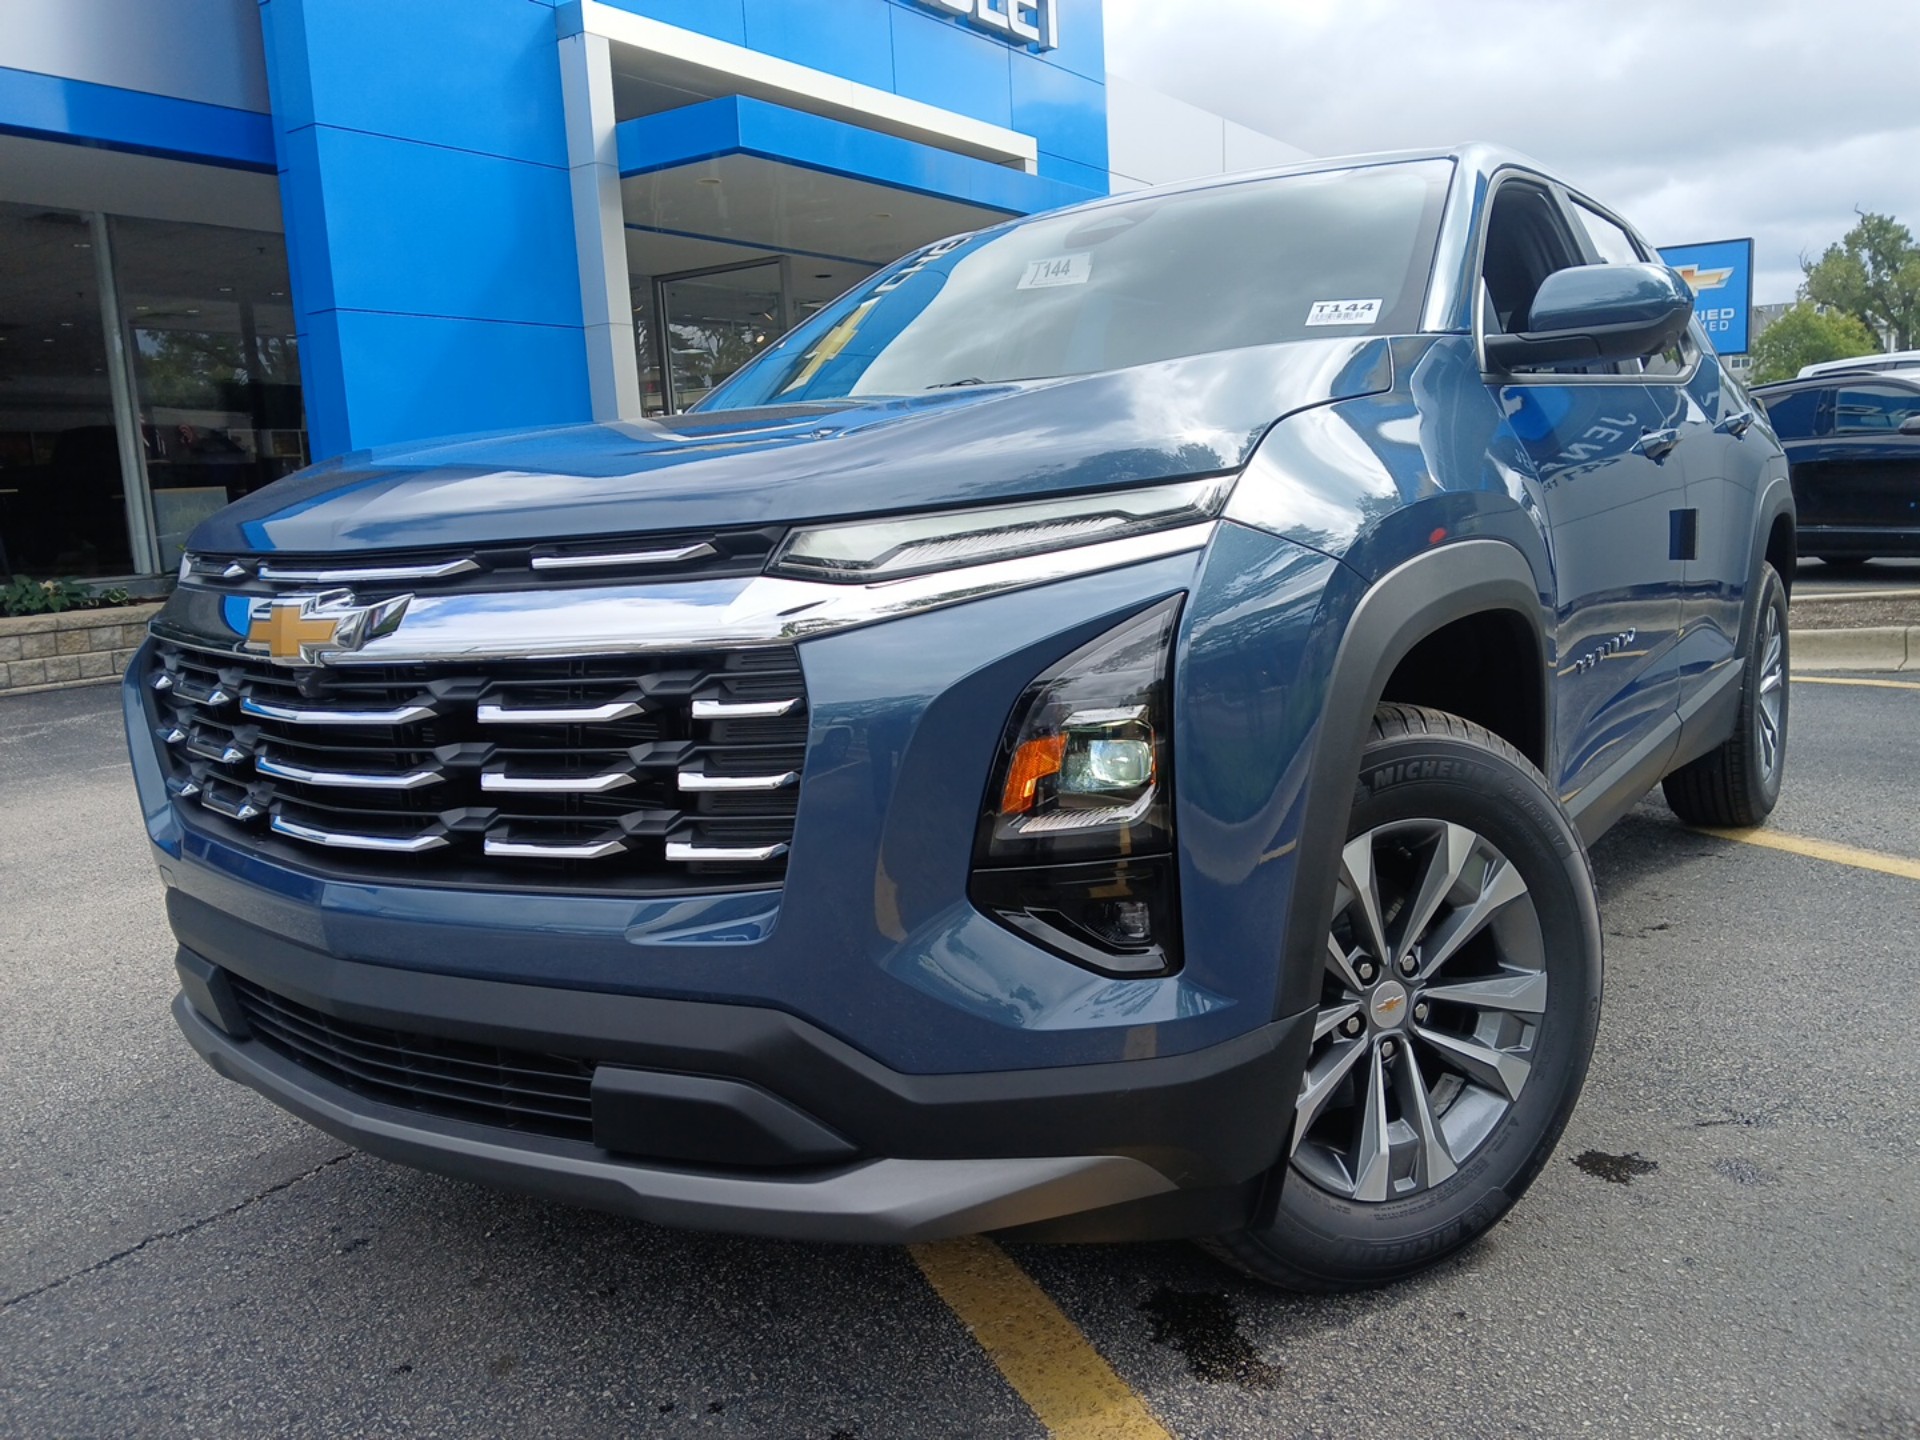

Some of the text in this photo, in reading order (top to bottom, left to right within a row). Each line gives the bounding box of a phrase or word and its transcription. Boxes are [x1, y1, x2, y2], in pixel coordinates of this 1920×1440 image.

[1316, 303, 1374, 313] T144
[1695, 308, 1735, 320] IED
[1703, 320, 1729, 331] ED
[1373, 760, 1496, 790] MICHELIN
